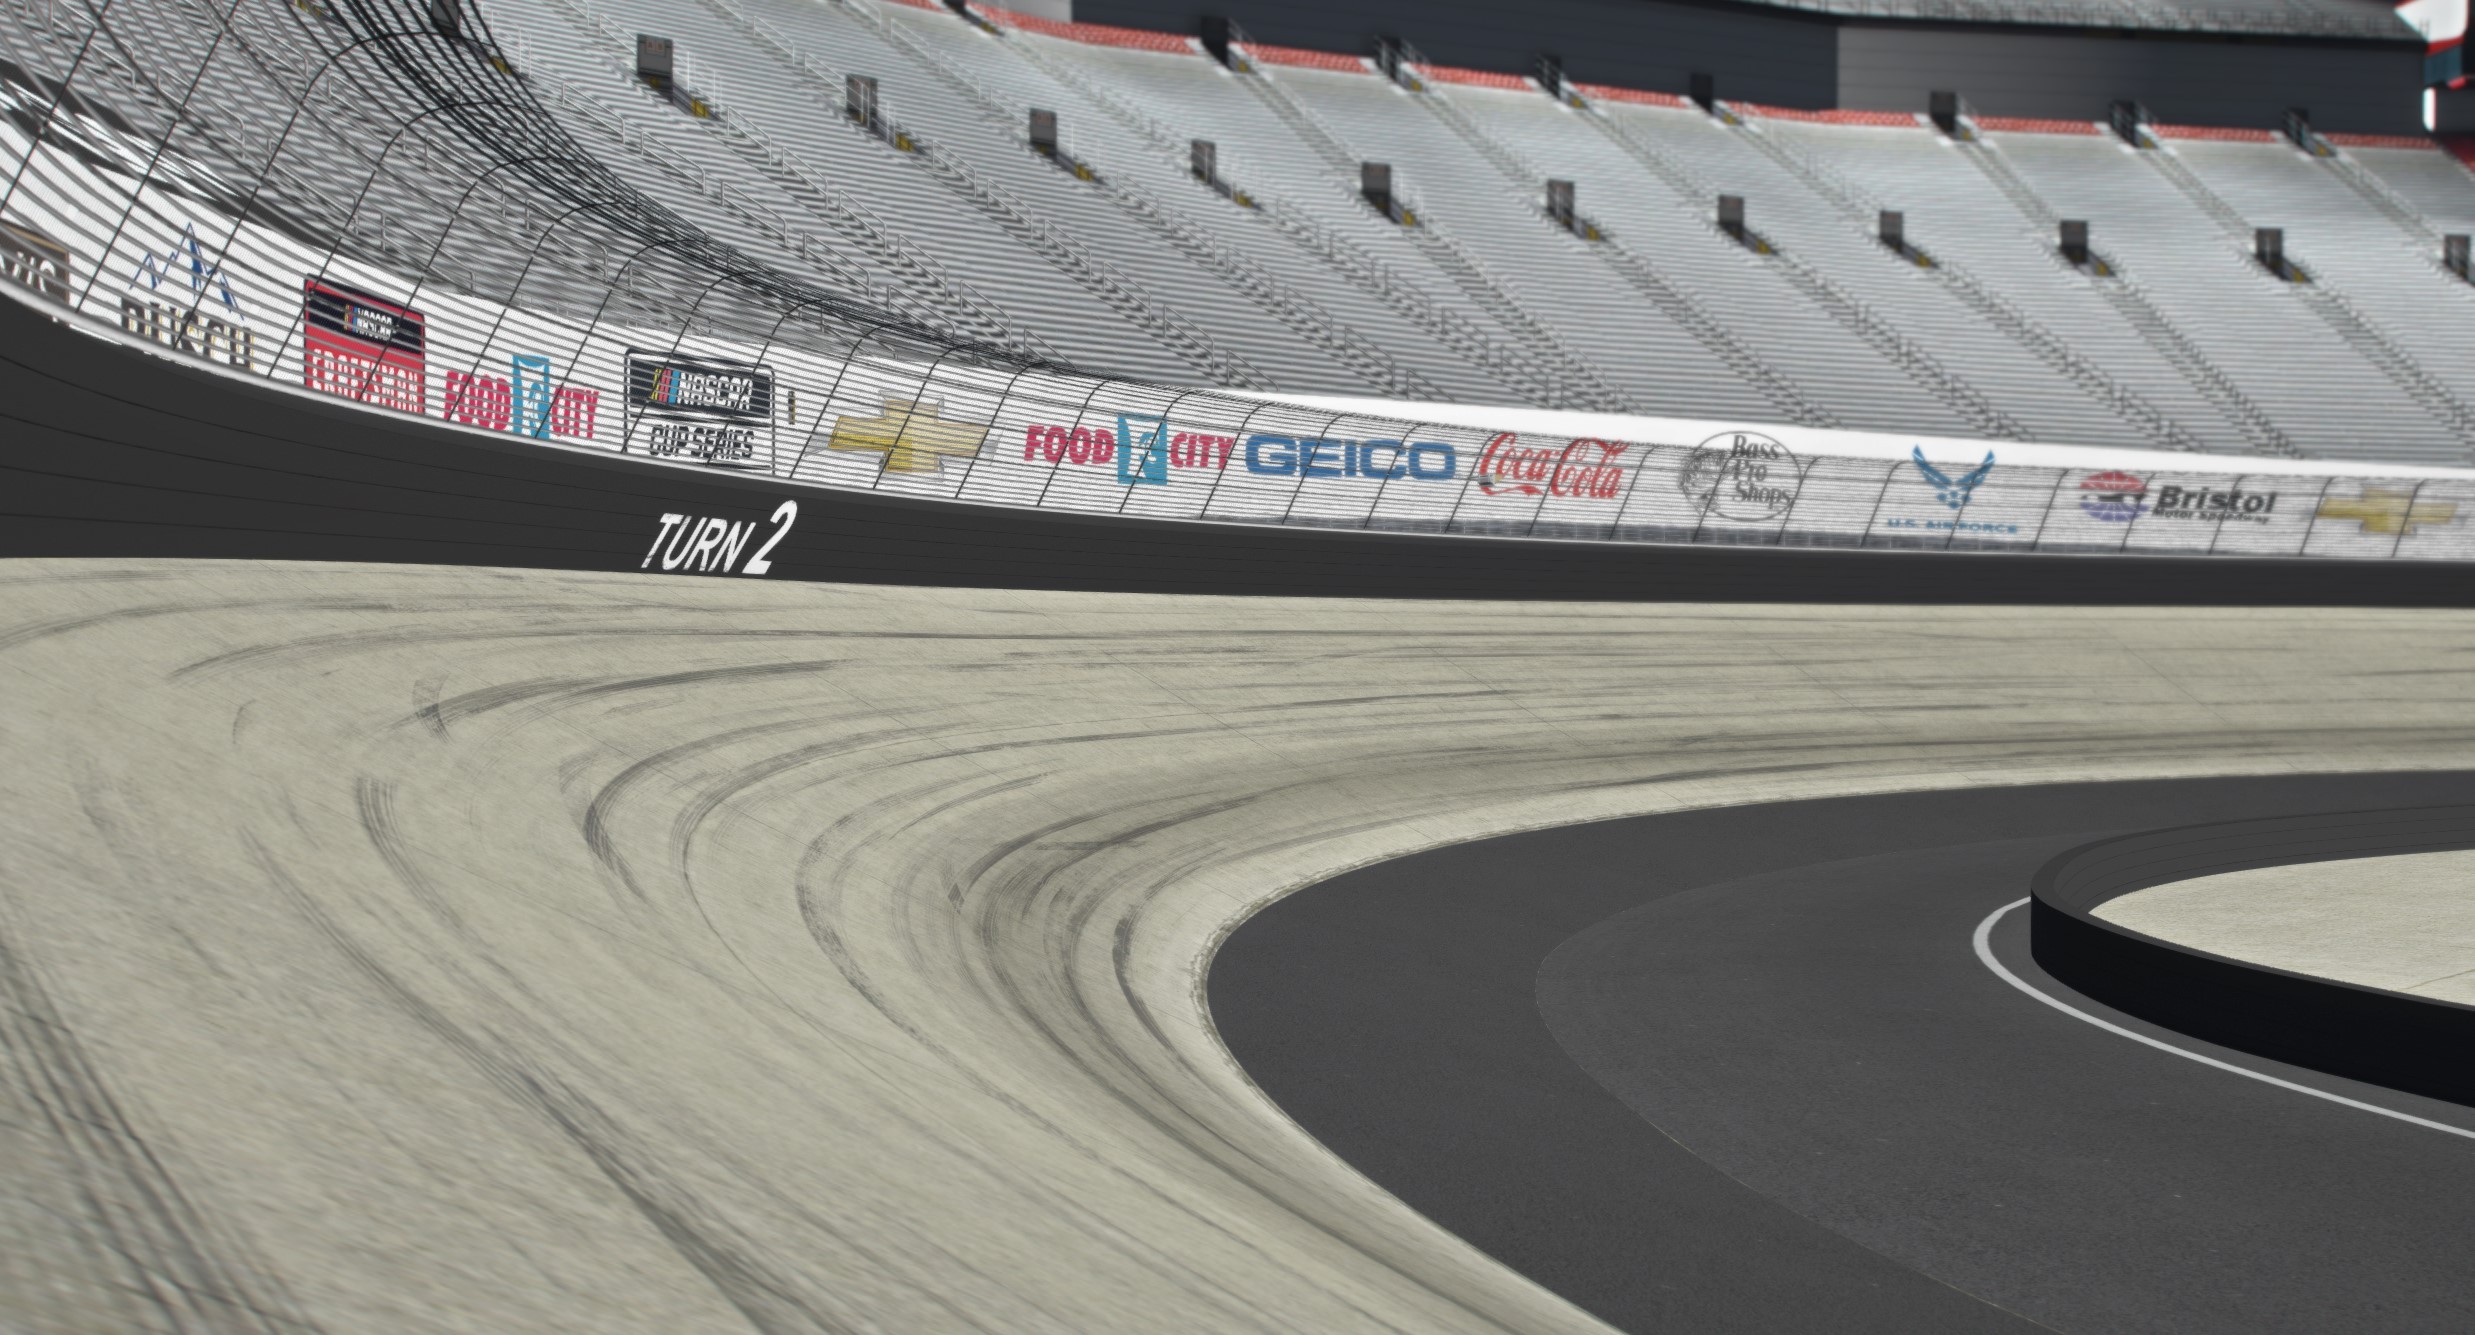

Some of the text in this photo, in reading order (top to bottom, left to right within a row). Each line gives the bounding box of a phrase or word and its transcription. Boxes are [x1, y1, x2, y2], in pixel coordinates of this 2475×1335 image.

[444, 370, 599, 438] FOOD CITY
[677, 373, 754, 411] NASCAR
[650, 425, 689, 457] CUP
[1024, 425, 1235, 469] FOOD CITY
[1246, 435, 1456, 480] GEICO
[1731, 435, 1780, 460] Bass
[1732, 459, 1767, 482] Pro
[1735, 480, 1791, 509] Shops
[2157, 485, 2278, 514] Bristol
[641, 500, 798, 575] TURN 2
